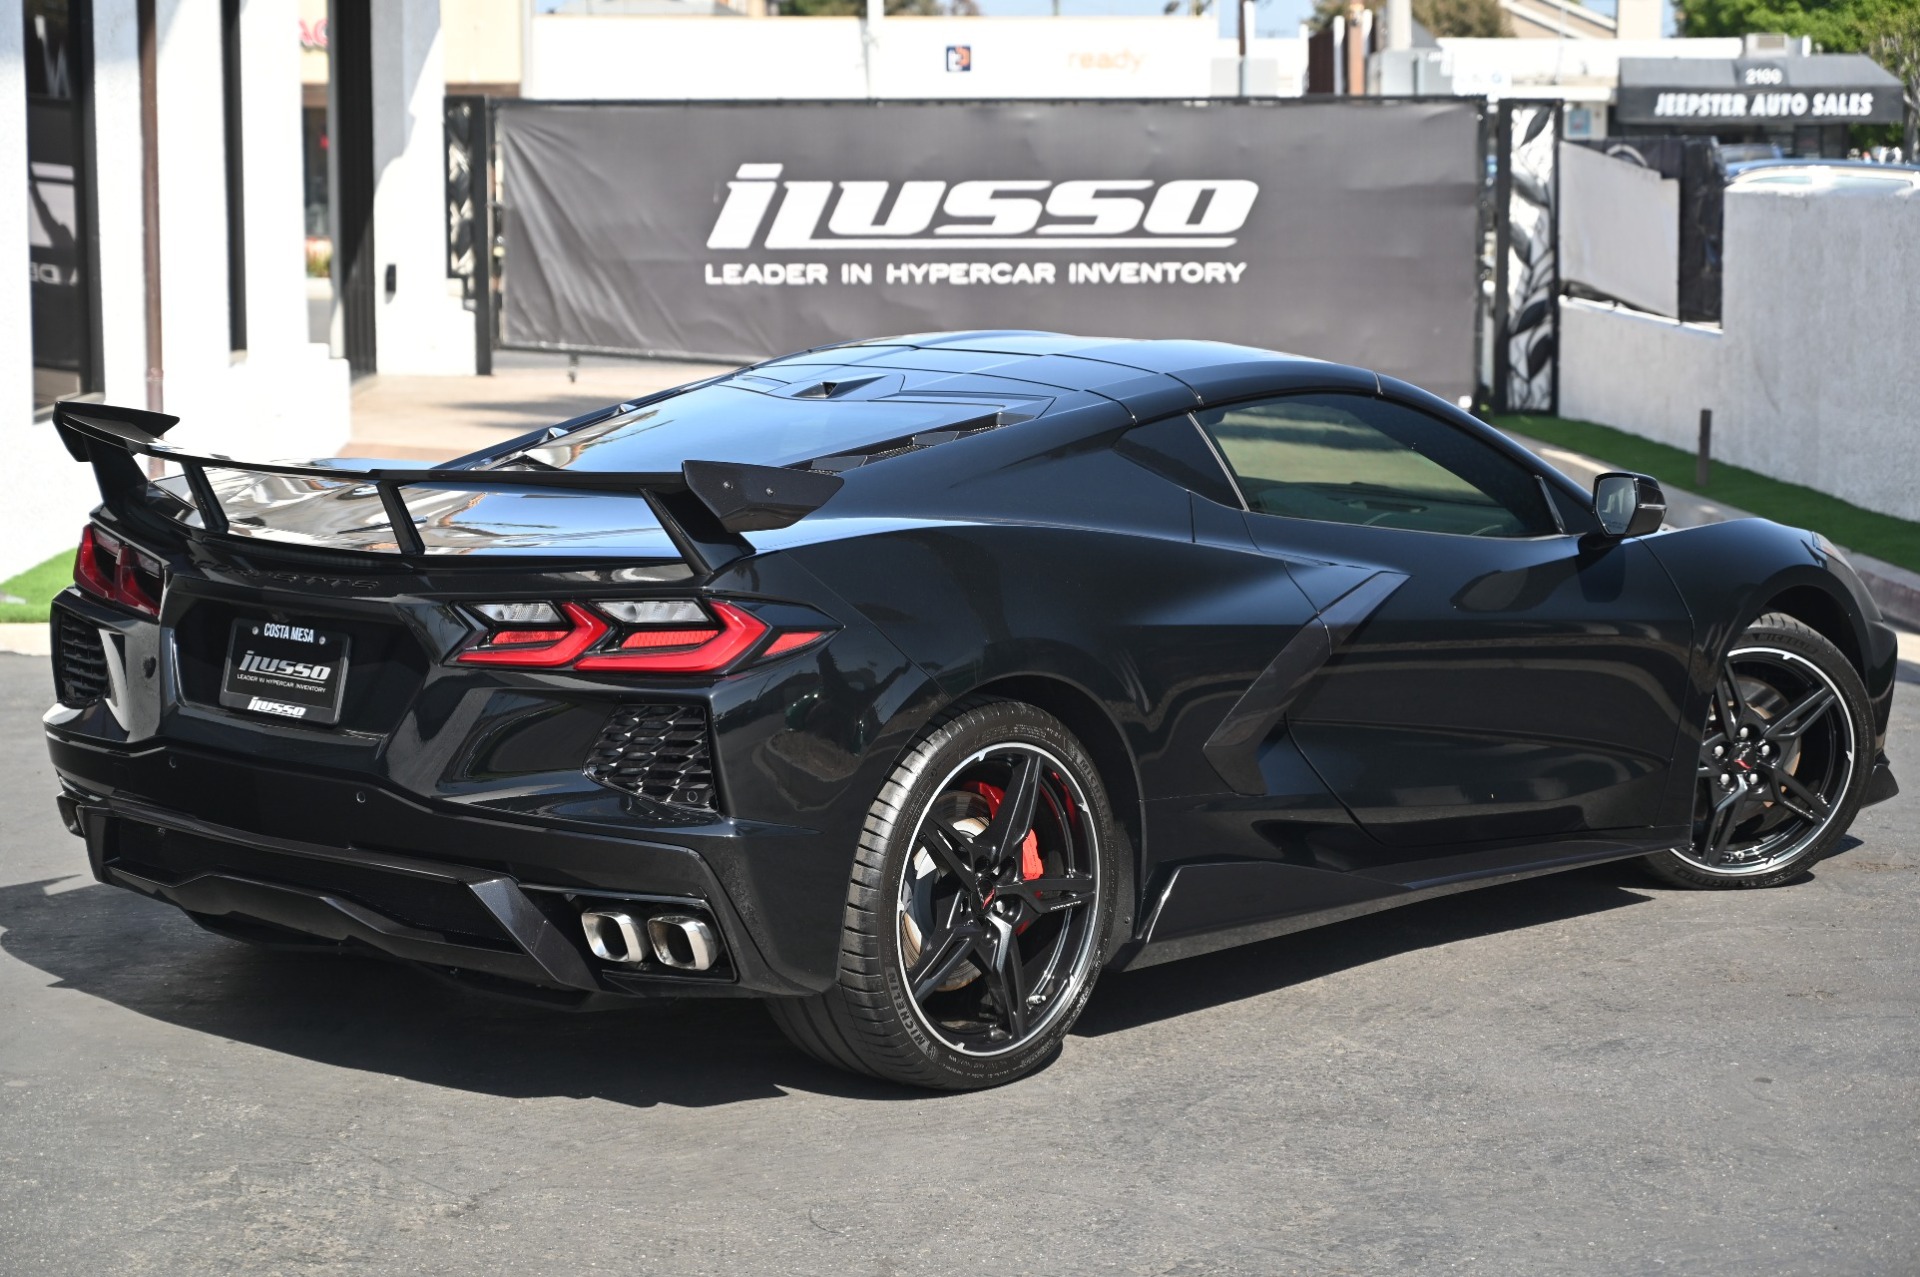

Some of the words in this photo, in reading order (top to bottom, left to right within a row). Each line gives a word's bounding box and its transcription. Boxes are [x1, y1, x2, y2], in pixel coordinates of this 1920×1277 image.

[1655, 92, 1748, 117] JEEPSTER
[1750, 92, 1809, 117] AUTO
[1811, 92, 1874, 117] SALES
[705, 262, 829, 286] LEADER
[840, 262, 873, 286] IN
[885, 262, 1057, 286] HYPERCAR
[1067, 261, 1248, 285] INVENTORY
[264, 622, 290, 640] COSTA
[290, 626, 315, 643] MESA
[266, 678, 295, 689] HYPERCAR
[295, 682, 327, 693] INVENTORY
[887, 971, 928, 1048] MICHELIN
